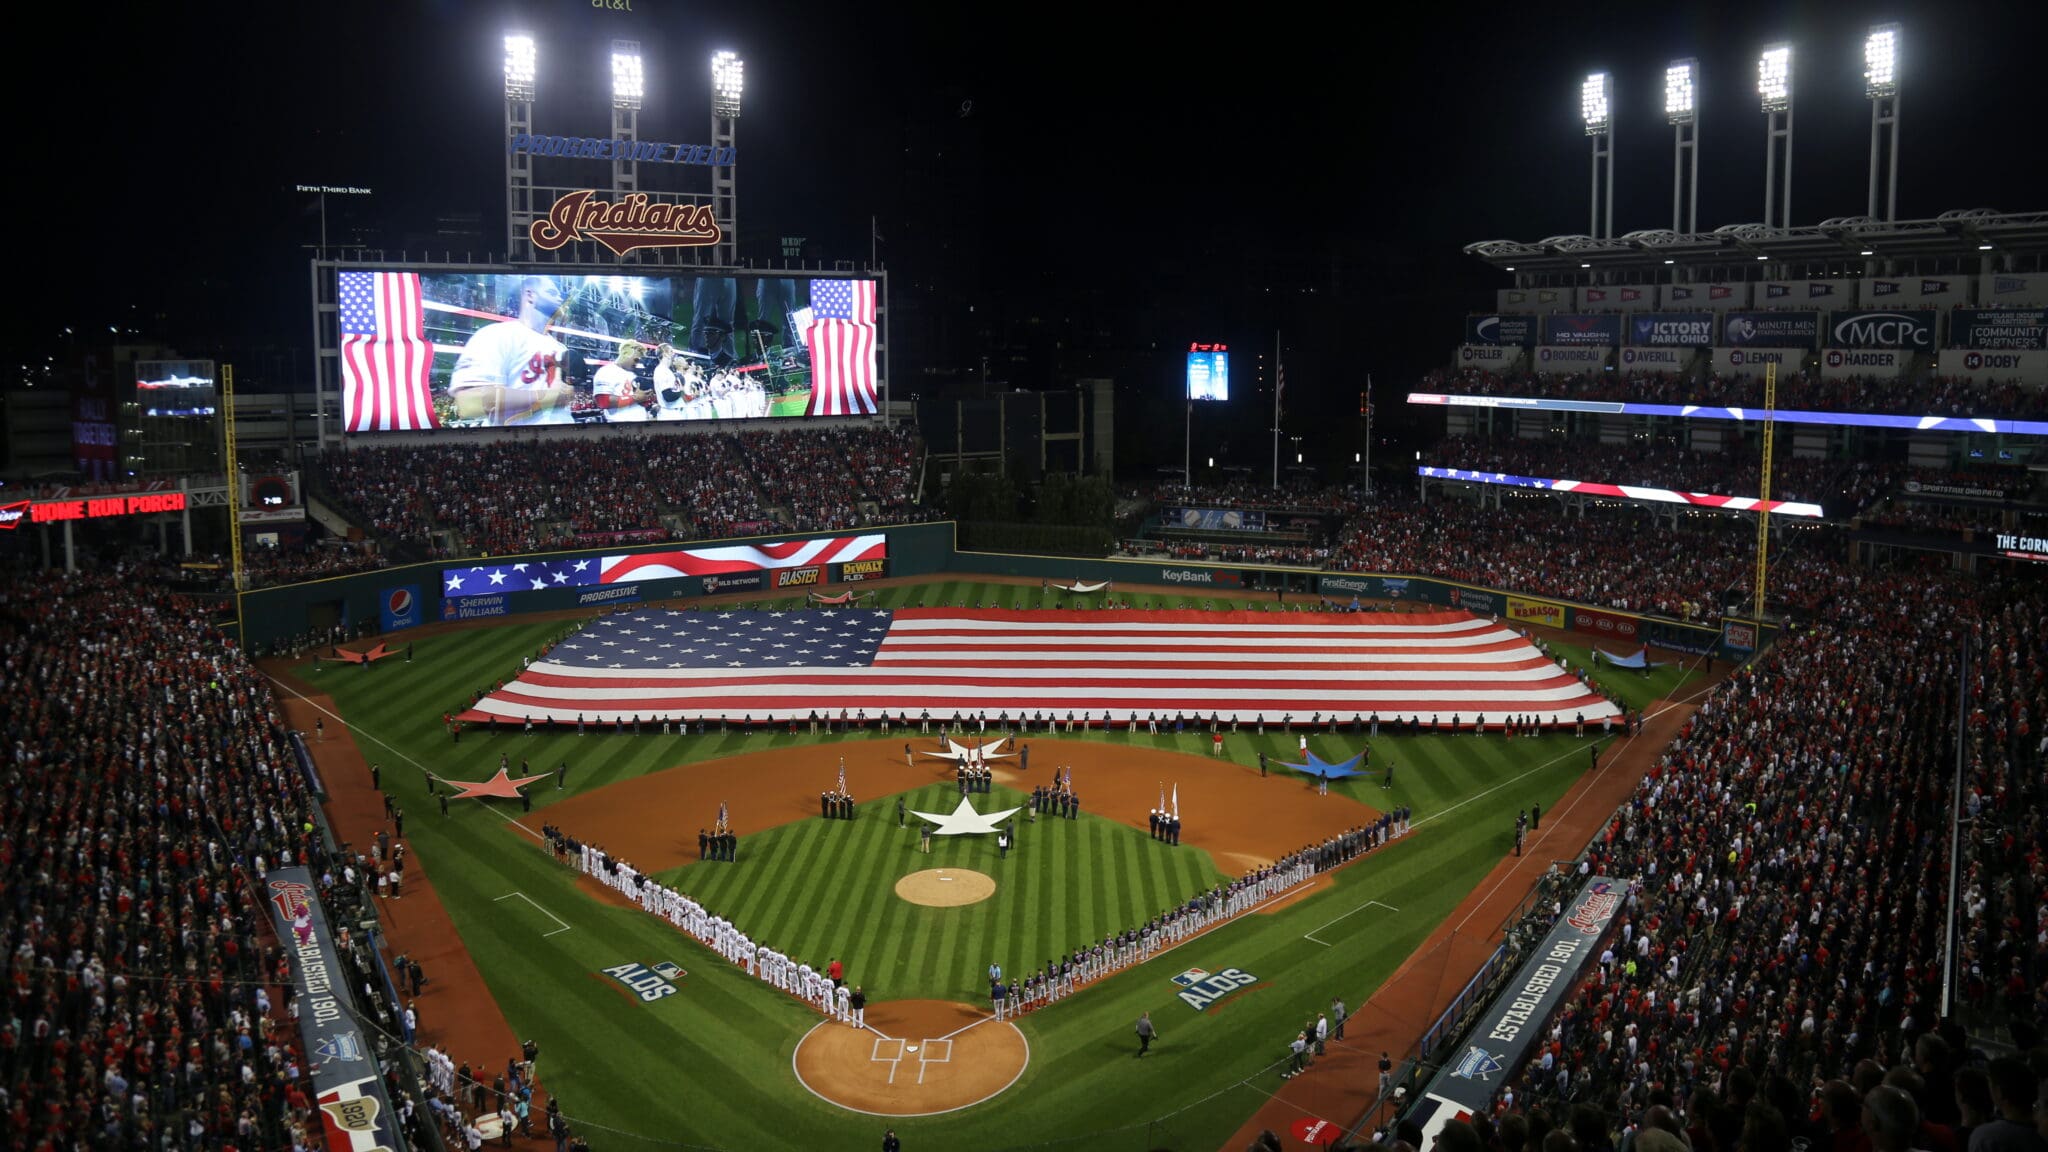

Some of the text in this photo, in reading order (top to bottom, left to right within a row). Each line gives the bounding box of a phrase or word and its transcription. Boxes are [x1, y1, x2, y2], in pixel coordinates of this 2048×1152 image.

[508, 133, 737, 167] PROGRESSIVE FIELD
[296, 185, 320, 193] FIFTH
[322, 186, 347, 194] THIRD
[530, 190, 721, 253] Indians
[1758, 320, 1815, 329] MINUTE MEN
[1651, 334, 1710, 344] PARK OHIO
[1975, 327, 2044, 338] COMMUNITY
[1979, 337, 2039, 348] PARTNERS
[1474, 350, 1503, 360] FELLER
[1553, 350, 1599, 361] BOUDREAU
[1637, 351, 1676, 362] AVERILL
[1732, 353, 1783, 364] 21 LEMON
[1844, 354, 1894, 366] HARDER
[1967, 355, 2021, 368] 14 DOBY
[31, 493, 186, 523] HOME RUN PORCH
[1996, 534, 2017, 549] THE
[732, 577, 760, 586] NETWORK
[779, 569, 820, 586] BLASTER
[1162, 569, 1212, 584] KeyBank
[1321, 577, 1369, 592] FirstEnergy
[579, 586, 639, 603] PROGRESSIVE
[1460, 589, 1494, 603] University
[459, 597, 503, 608] SHERWIN
[1727, 628, 1749, 639] drug
[602, 963, 677, 1001] ALDS
[1178, 968, 1258, 1010] ALDS
[1489, 963, 1562, 1042] ESTABLISHED
[340, 1100, 368, 1128] 1920
